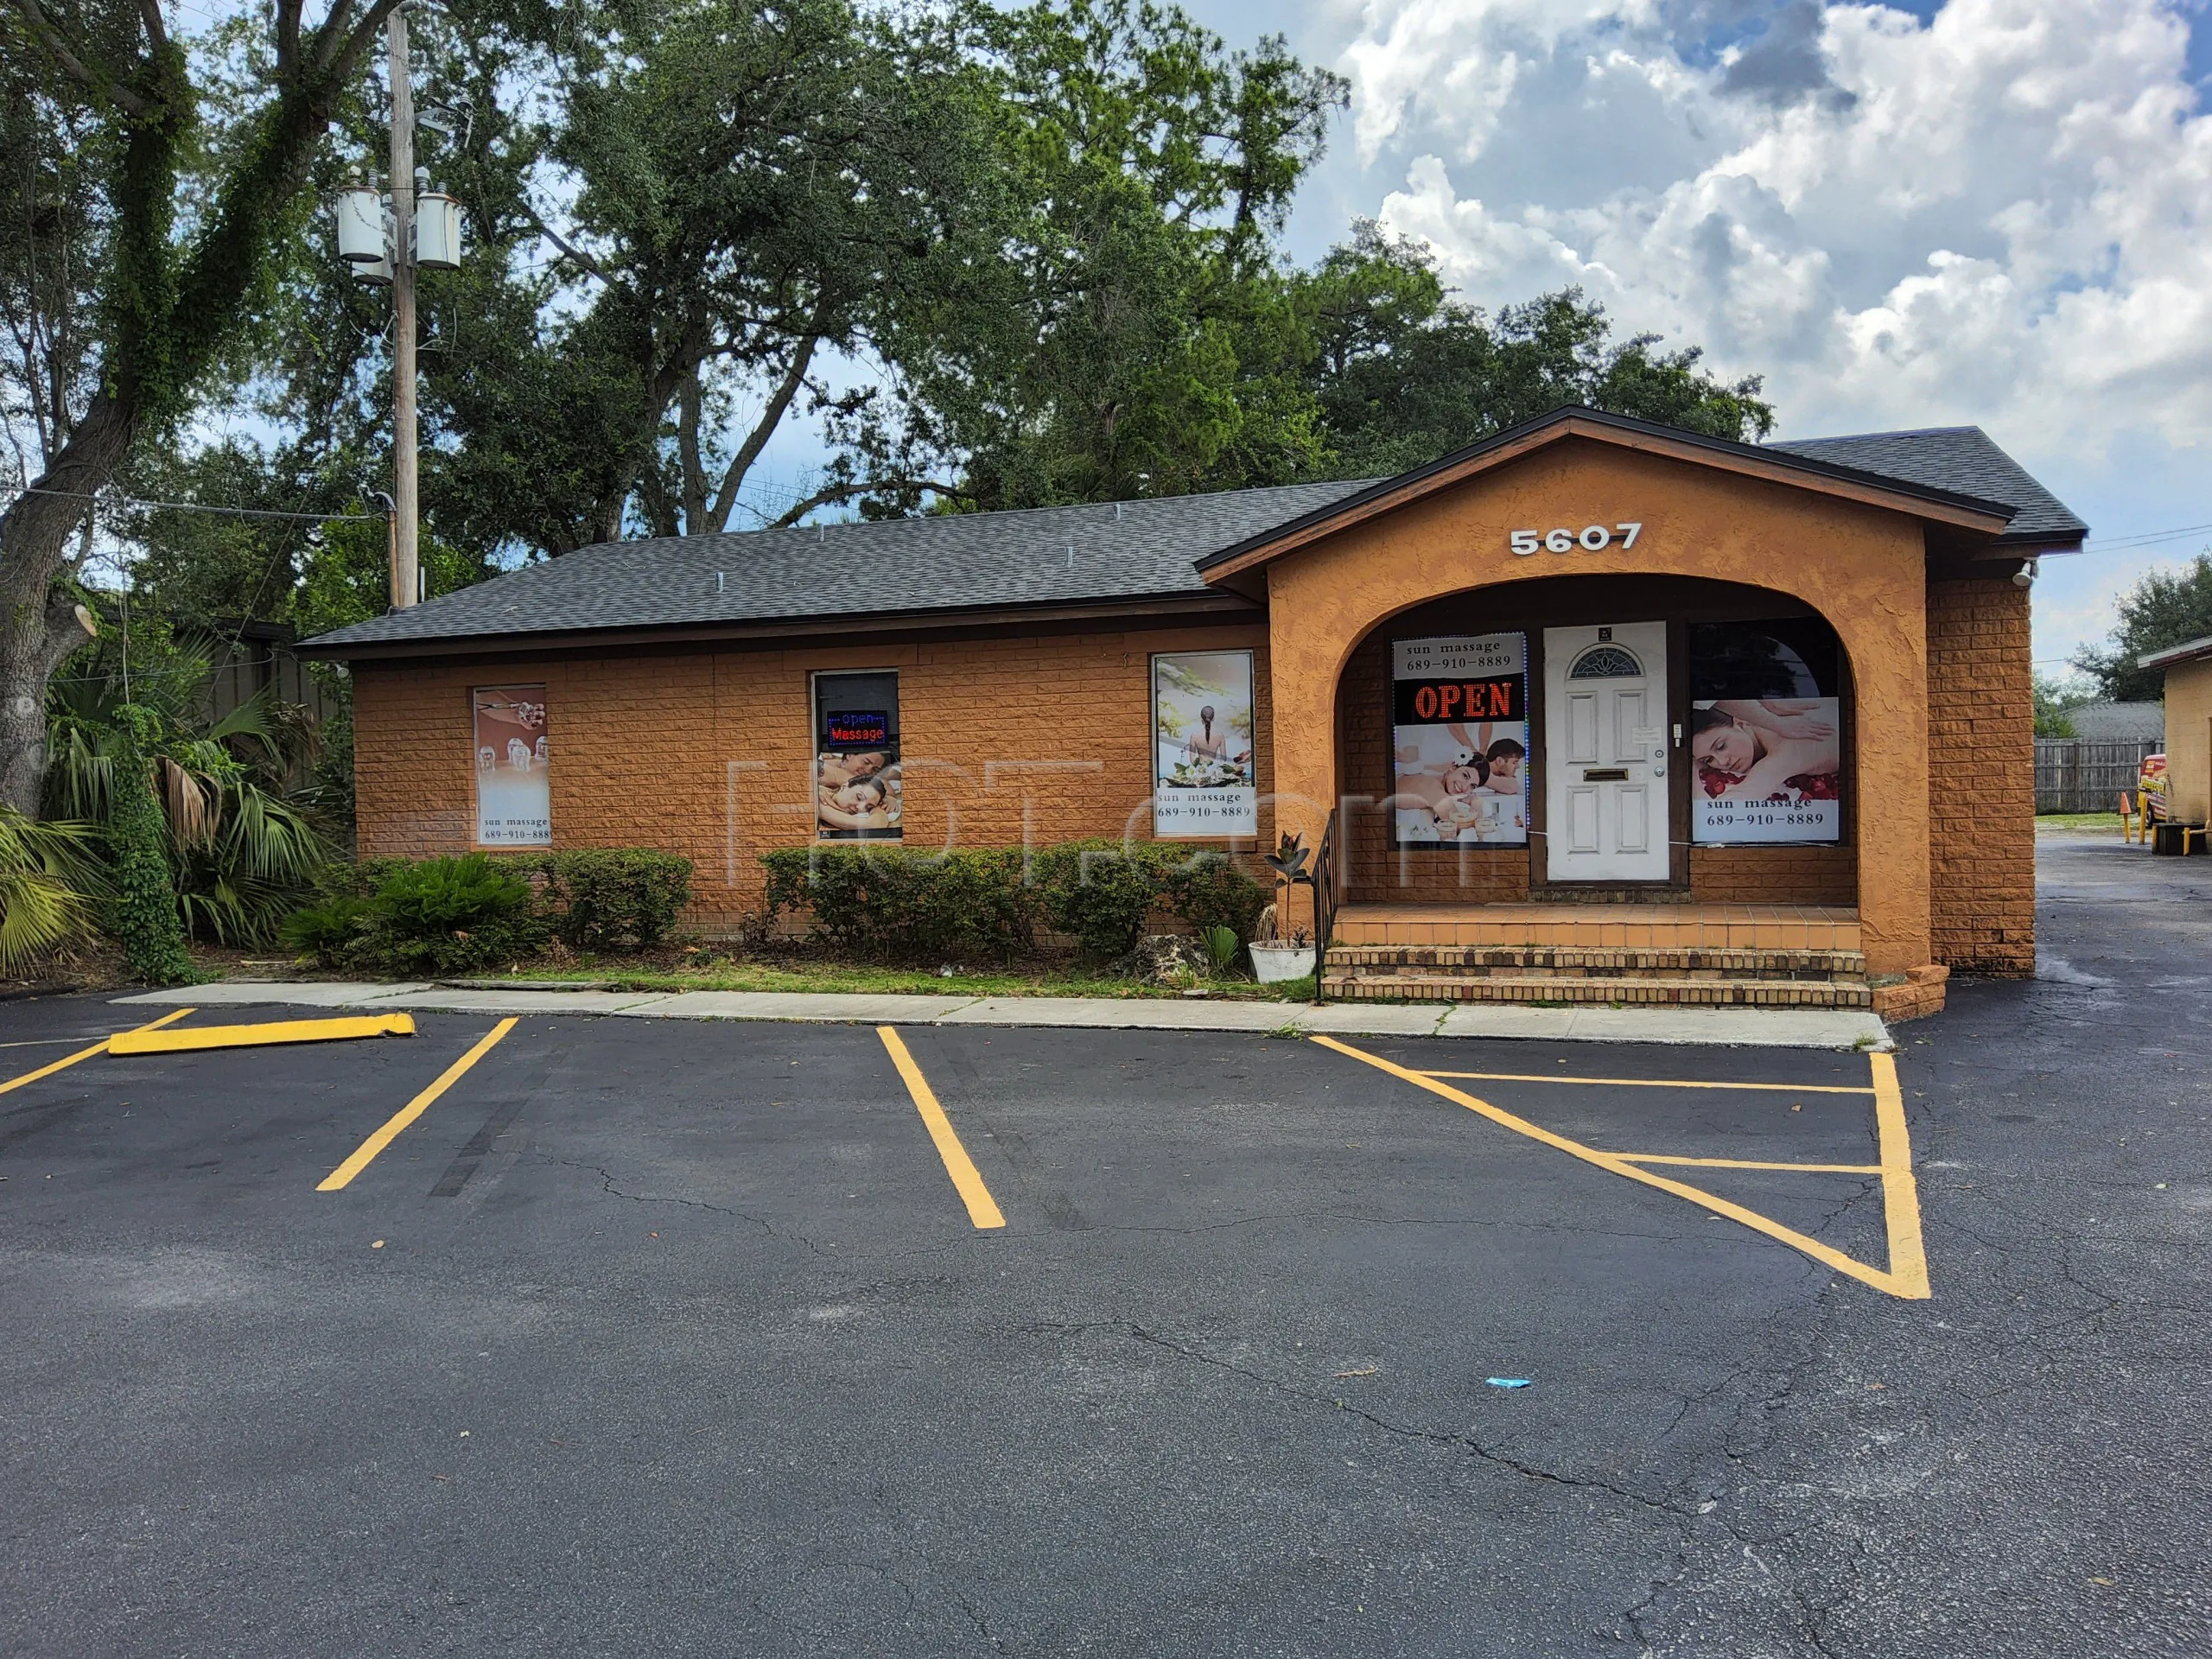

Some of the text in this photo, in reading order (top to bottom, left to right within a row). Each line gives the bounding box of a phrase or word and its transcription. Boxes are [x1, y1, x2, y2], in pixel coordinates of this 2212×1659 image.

[1510, 523, 1643, 556] 5607
[1407, 642, 1501, 655] sun massage
[1407, 655, 1510, 671] 689-910-8889
[1415, 683, 1512, 718] OPEN
[831, 728, 884, 742] Massage
[1187, 794, 1242, 804] massage
[1707, 798, 1813, 810] sun massage
[1158, 806, 1251, 817] 689-910-8889
[506, 819, 548, 828] massage
[1707, 813, 1824, 826] 689-910-8889
